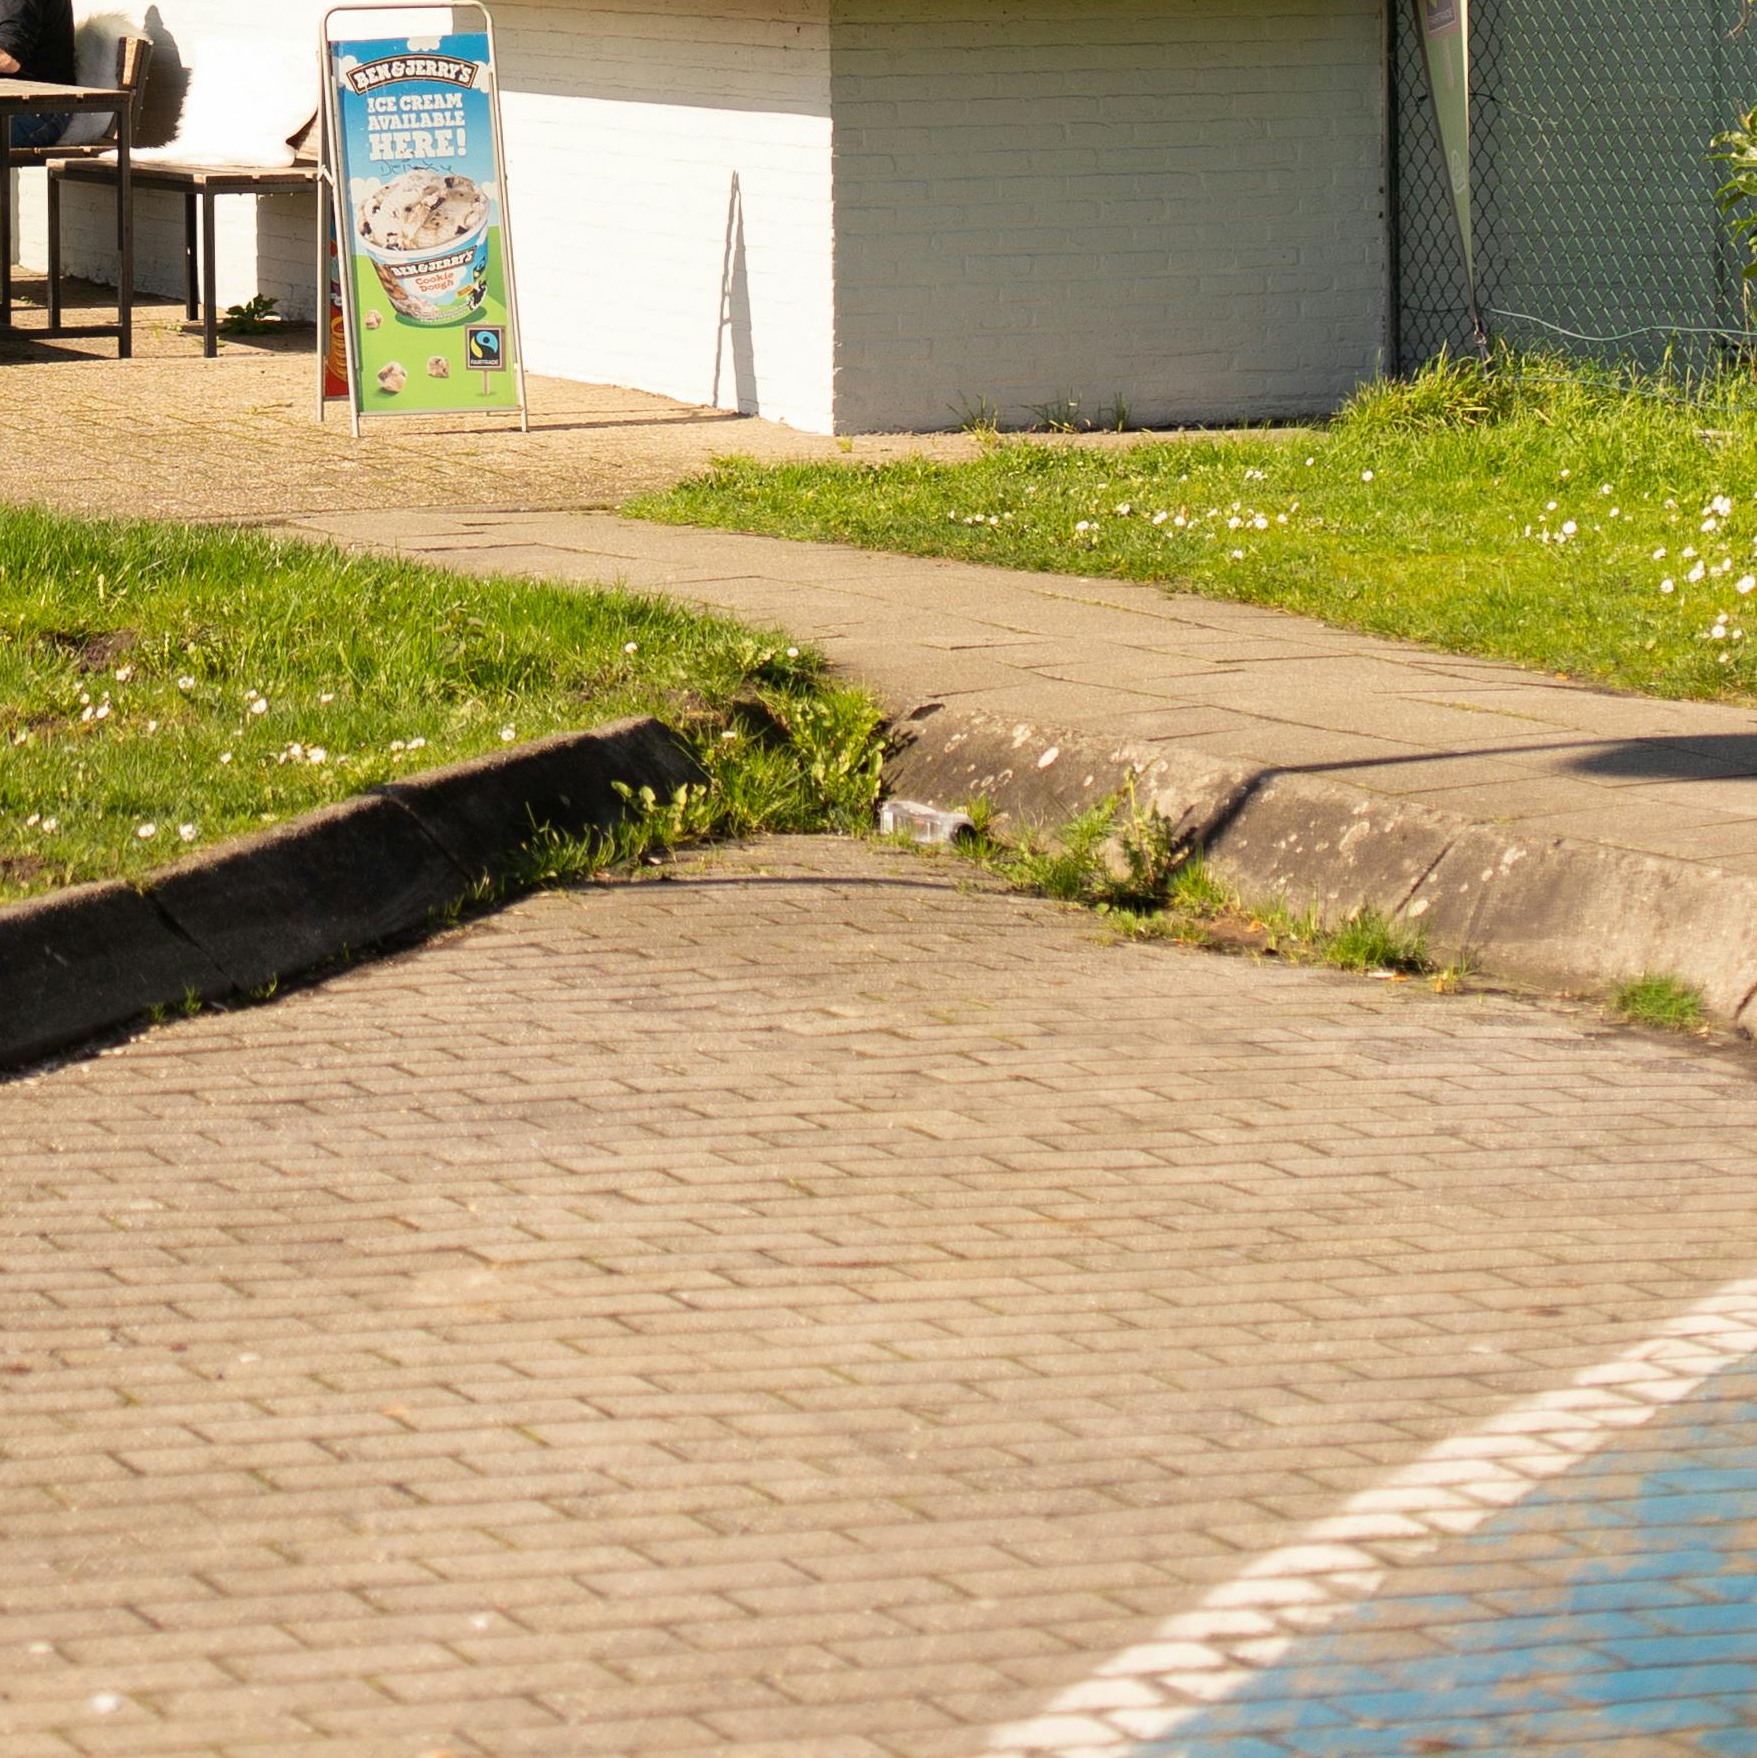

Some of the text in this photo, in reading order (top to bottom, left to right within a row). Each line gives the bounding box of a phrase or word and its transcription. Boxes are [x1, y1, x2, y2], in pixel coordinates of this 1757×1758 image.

[367, 93, 463, 113] ICE CREAM
[368, 111, 465, 131] AVAILABLE
[415, 271, 454, 286] Cookie
[419, 280, 454, 293] Dough
